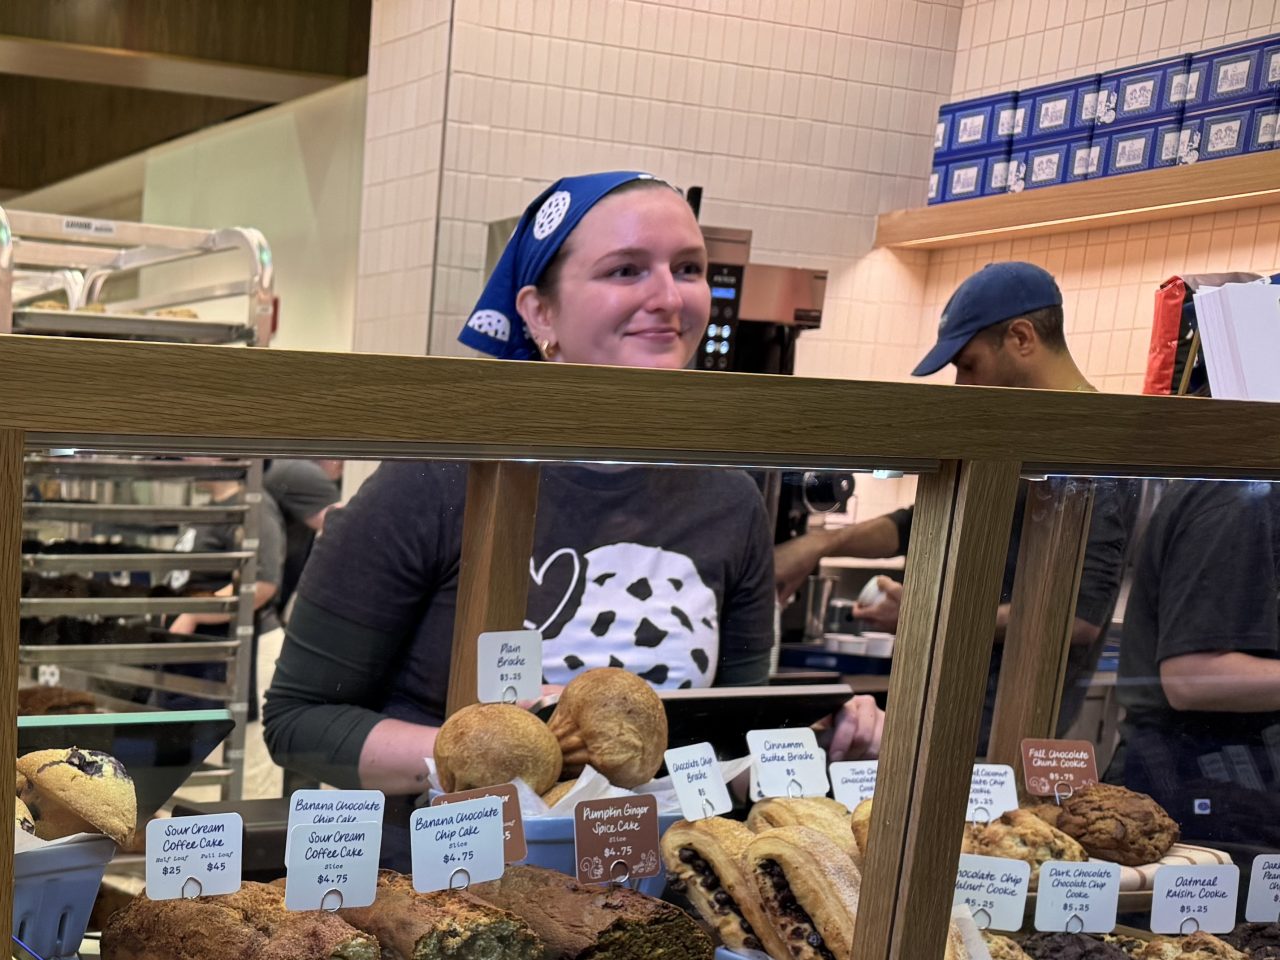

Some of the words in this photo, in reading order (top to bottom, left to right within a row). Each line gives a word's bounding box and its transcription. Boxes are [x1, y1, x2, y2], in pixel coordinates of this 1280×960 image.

[764, 740, 804, 751] Cinnamon
[1029, 748, 1046, 758] Fall
[1049, 749, 1089, 759] Chocolate
[1032, 758, 1057, 767] Chunk
[1060, 759, 1087, 768] Cookie
[295, 799, 334, 811] Banana
[335, 800, 380, 811] Chocolate
[583, 806, 622, 821] Pumpkin
[623, 803, 649, 819] Ginger
[415, 816, 454, 832] Banana
[455, 807, 499, 824] Chocolate
[165, 825, 191, 837] Sour
[191, 823, 225, 835] Cream
[592, 821, 617, 836] Spice
[618, 818, 641, 832] Cake
[308, 831, 333, 844] Sour
[333, 831, 365, 842] Cream
[434, 829, 456, 842] Chip
[458, 825, 480, 838] Cake
[163, 840, 198, 852] Coffee
[200, 837, 224, 849] Cake
[305, 846, 339, 860] Coffee
[340, 846, 364, 858] Cake
[443, 850, 474, 864] $4.75
[603, 846, 632, 857] $4.75
[162, 866, 181, 876] $25
[206, 862, 226, 872] $45
[317, 874, 348, 884] $4.75
[1000, 872, 1023, 887] Chip
[1049, 868, 1071, 878] Dark
[1073, 869, 1112, 879] Chocolate
[1052, 879, 1087, 889] Chocolate
[1088, 881, 1107, 891] Chip
[1175, 876, 1218, 888] Oatmeal
[955, 880, 985, 893] alnut
[986, 883, 1018, 897] Cookie
[1066, 889, 1090, 899] Cookie
[1166, 888, 1197, 899] Raisin
[1198, 888, 1228, 899] Cookie
[1063, 902, 1090, 912] $5.25
[1180, 905, 1208, 914] $5.25
